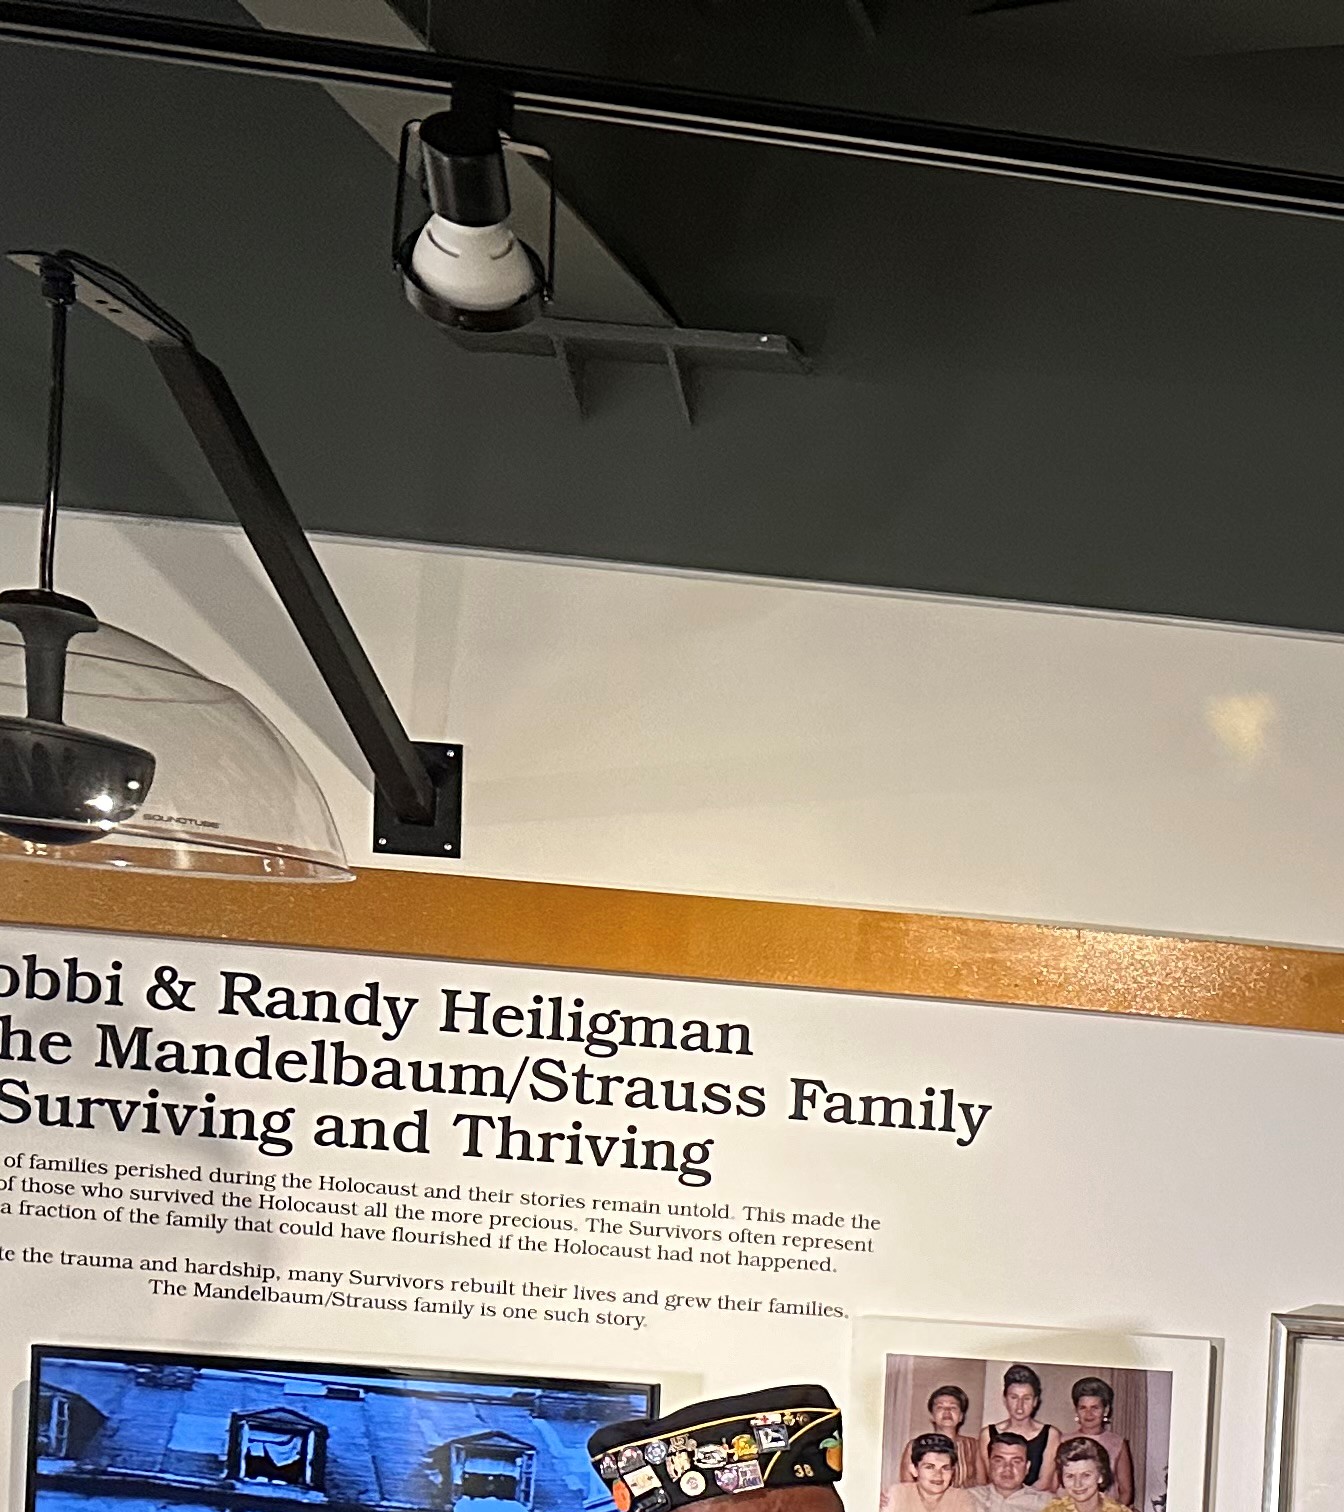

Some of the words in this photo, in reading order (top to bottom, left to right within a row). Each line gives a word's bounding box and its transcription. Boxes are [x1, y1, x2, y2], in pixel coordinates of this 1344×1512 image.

[147, 965, 196, 1012] &
[218, 970, 419, 1041] Randy
[440, 988, 753, 1059] Heiligman
[95, 1023, 765, 1118] Mandelbaum/Strauss
[788, 1077, 992, 1146] Family
[0, 1078, 295, 1157] Surviving
[314, 1108, 430, 1155] and
[453, 1113, 714, 1188] Thriving
[4, 1153, 25, 1169] of
[30, 1153, 107, 1175] families
[115, 1163, 202, 1182] perished
[209, 1167, 276, 1192] during
[282, 1172, 312, 1189] the
[319, 1175, 418, 1197] Holocaust
[424, 1184, 461, 1200] and
[469, 1186, 513, 1204] their
[520, 1192, 585, 1209] stories
[593, 1199, 661, 1214] remain
[668, 1203, 735, 1219] untold.
[743, 1205, 785, 1223] This
[793, 1212, 844, 1227] made
[852, 1214, 880, 1231] the
[22, 1176, 75, 1195] those
[81, 1182, 123, 1199] who
[130, 1188, 213, 1206] survived
[222, 1191, 252, 1208] the
[259, 1194, 357, 1216] Holocaust
[364, 1201, 386, 1218] all
[395, 1203, 424, 1221] the
[432, 1210, 482, 1224] more
[489, 1214, 577, 1231] precious.
[586, 1218, 622, 1235] The
[629, 1221, 721, 1242] Survivors
[729, 1228, 775, 1245] often
[783, 1236, 872, 1252] represent
[1, 1202, 11, 1215] a
[19, 1200, 96, 1220] fraction
[104, 1206, 124, 1222] of
[129, 1207, 159, 1225] the
[167, 1210, 228, 1234] family
[235, 1215, 273, 1233] that
[279, 1220, 332, 1237] could
[341, 1222, 385, 1241] have
[392, 1226, 490, 1249] flourished
[499, 1234, 513, 1250] if
[518, 1235, 547, 1252] the
[554, 1237, 650, 1259] Holocaust
[657, 1244, 693, 1262] had
[700, 1251, 730, 1265] not
[738, 1250, 836, 1273] happened.
[23, 1247, 53, 1264] the
[61, 1250, 133, 1270] trauma
[140, 1256, 177, 1272] and
[185, 1257, 280, 1284] hardship,
[288, 1269, 343, 1288] many
[349, 1269, 444, 1290] Survivors
[451, 1277, 514, 1296] rebuilt
[523, 1281, 567, 1298] their
[574, 1284, 616, 1303] lives
[623, 1290, 658, 1306] and
[665, 1294, 711, 1311] grew
[718, 1294, 762, 1312] their
[769, 1297, 848, 1318] families.
[149, 1279, 186, 1296] The
[194, 1281, 407, 1311] Mandelbaum/Strauss
[414, 1297, 474, 1320] family
[481, 1303, 496, 1317] is
[503, 1306, 537, 1320] one
[544, 1308, 588, 1323] such
[596, 1312, 645, 1330] story.
